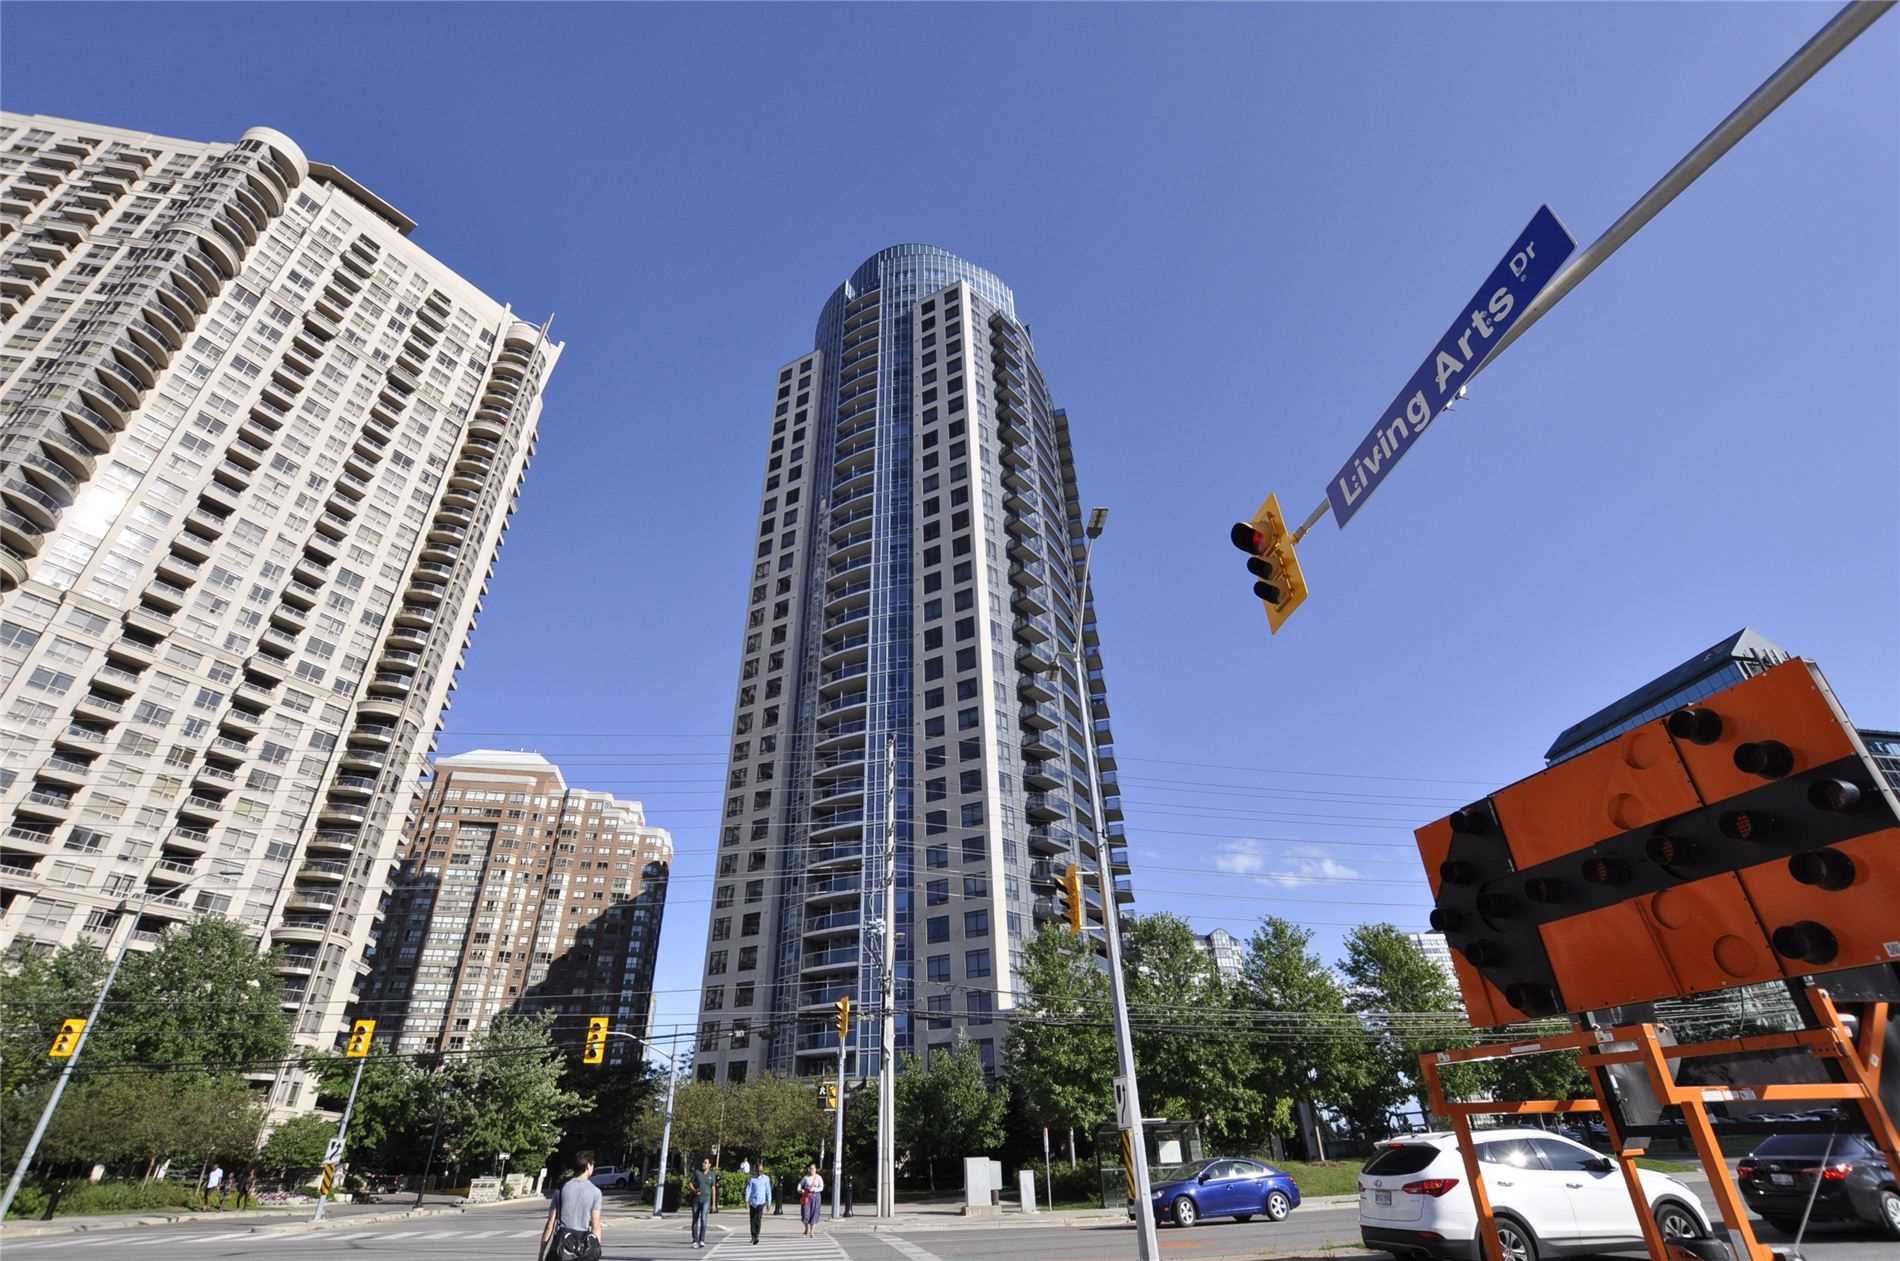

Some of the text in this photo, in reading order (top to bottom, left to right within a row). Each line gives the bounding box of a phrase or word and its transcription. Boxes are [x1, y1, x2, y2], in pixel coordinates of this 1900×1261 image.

[1339, 240, 1536, 506] Living Arts Dr
